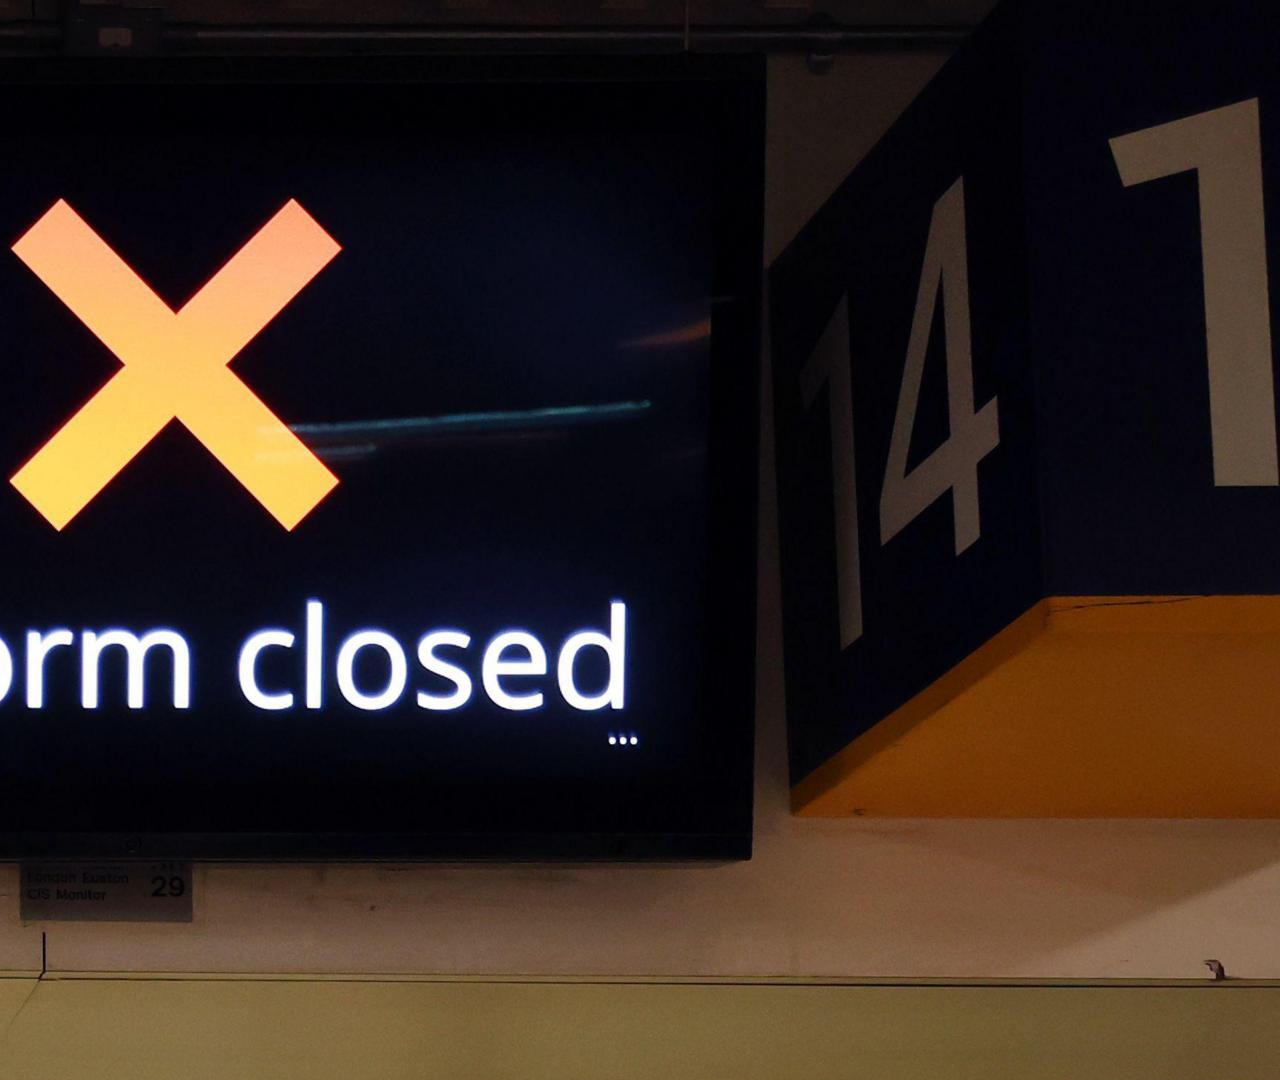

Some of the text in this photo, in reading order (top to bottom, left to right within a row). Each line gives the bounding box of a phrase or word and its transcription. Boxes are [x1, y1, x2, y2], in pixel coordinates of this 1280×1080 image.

[1108, 97, 1280, 486] 1
[798, 175, 1000, 651] 14
[237, 599, 628, 711] closed
[56, 888, 106, 902] Monitor
[151, 875, 185, 898] 29
